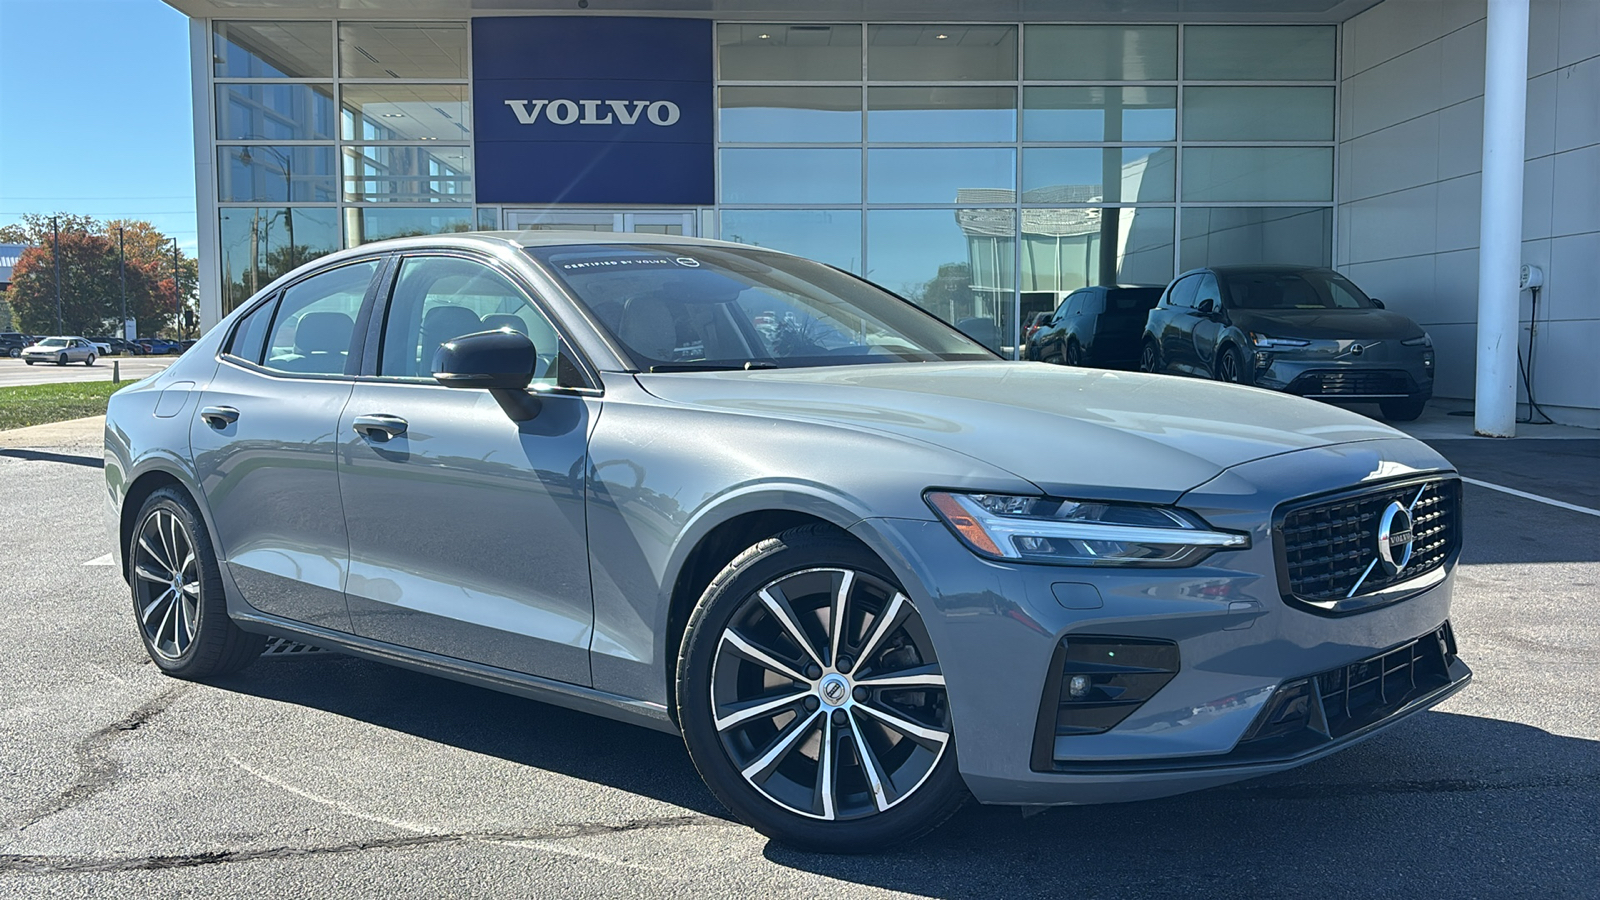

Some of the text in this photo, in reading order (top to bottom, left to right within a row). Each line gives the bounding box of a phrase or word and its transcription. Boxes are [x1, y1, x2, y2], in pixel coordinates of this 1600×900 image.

[504, 99, 680, 126] VOLVO
[564, 261, 618, 269] CERTIFIED
[1390, 532, 1411, 543] VOLVO
